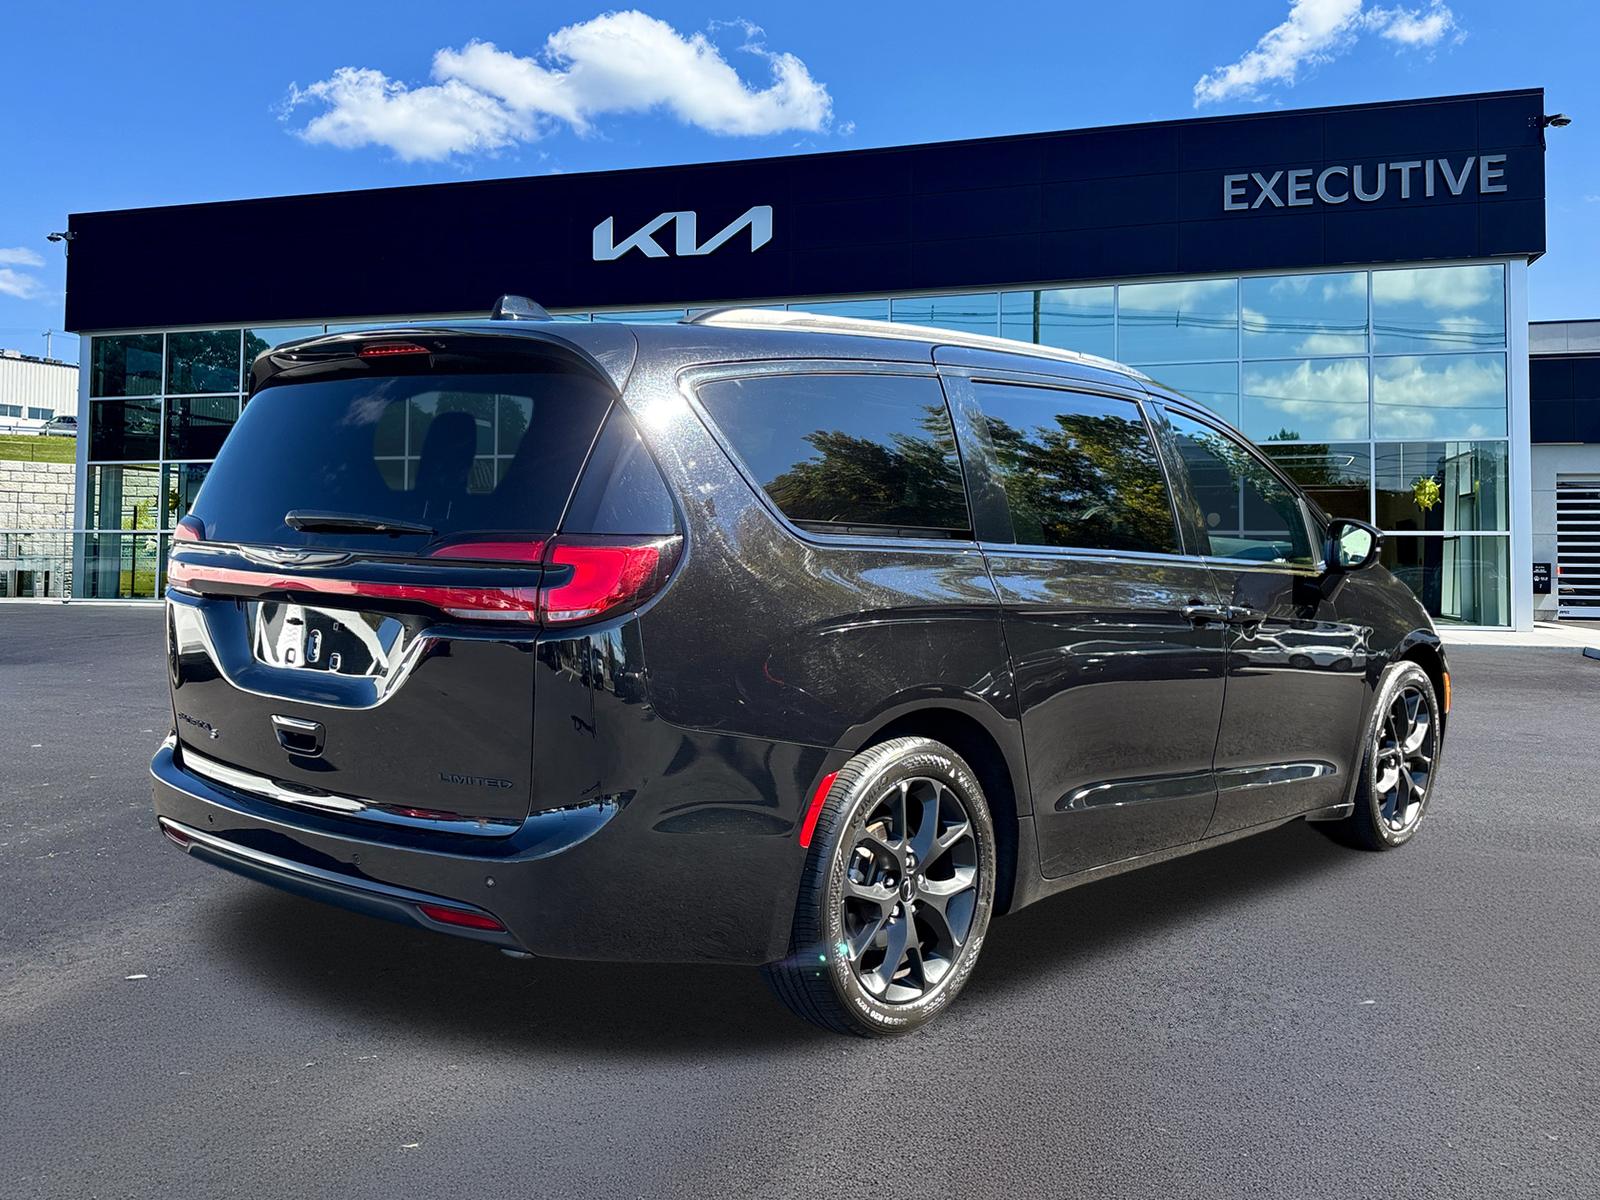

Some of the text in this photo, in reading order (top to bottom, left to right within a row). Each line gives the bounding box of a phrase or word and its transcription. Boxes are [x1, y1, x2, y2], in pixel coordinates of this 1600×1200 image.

[1223, 154, 1508, 211] EXECUTIVE
[593, 205, 773, 261] KIA
[439, 771, 513, 789] LIMITED
